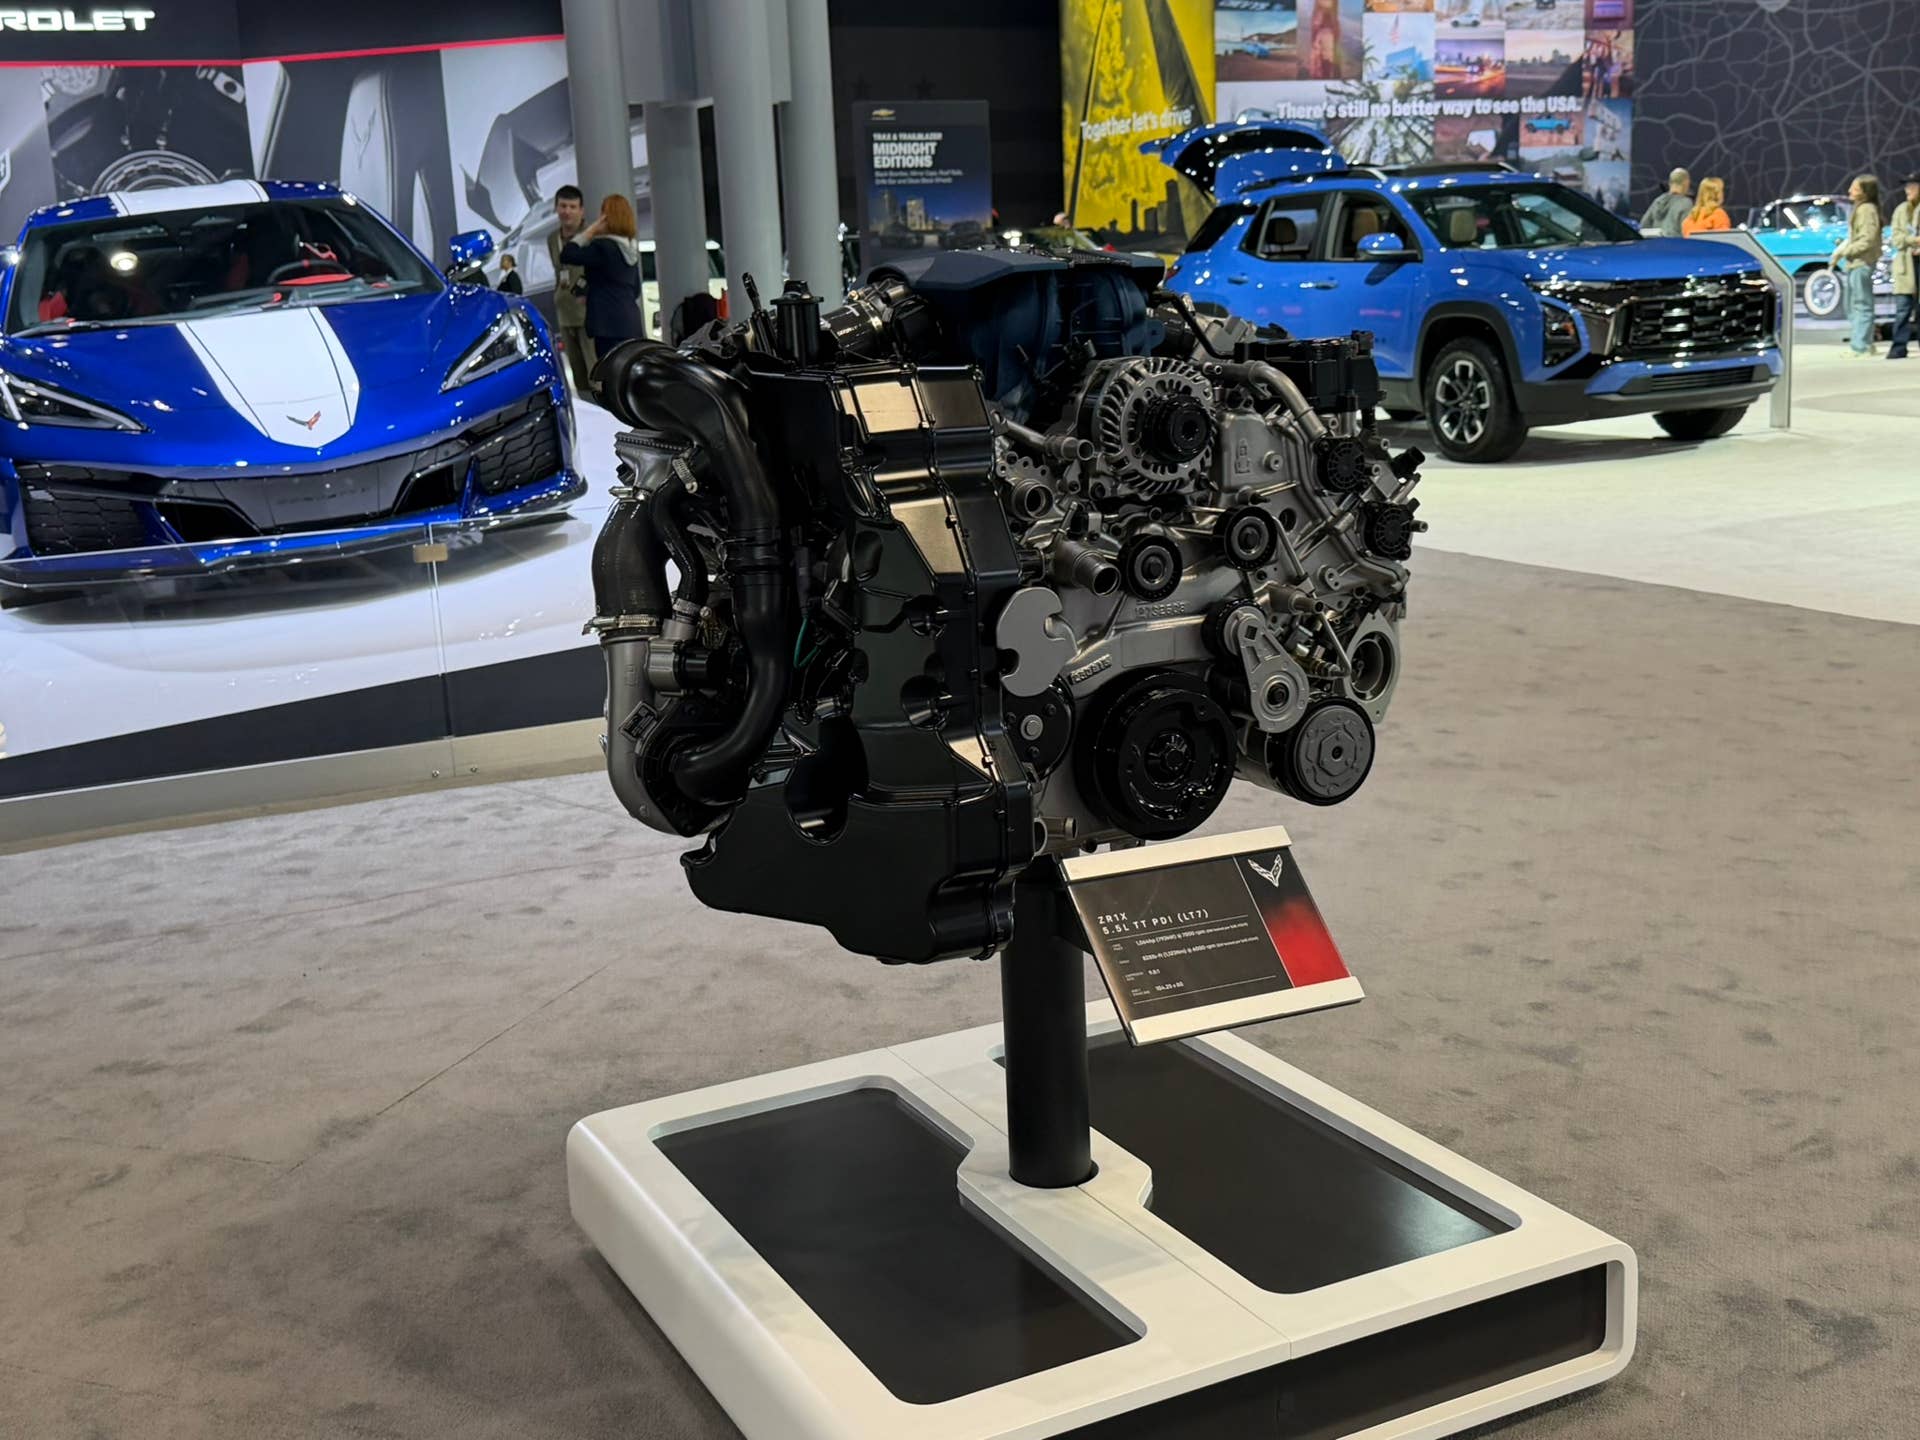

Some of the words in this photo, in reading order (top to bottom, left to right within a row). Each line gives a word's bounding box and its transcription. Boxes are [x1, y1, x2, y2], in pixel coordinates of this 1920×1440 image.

[1278, 100, 1336, 119] There's
[1338, 99, 1369, 118] still
[1370, 101, 1391, 117] no
[1392, 98, 1441, 117] better
[1442, 99, 1473, 118] way
[1474, 98, 1492, 114] to
[1493, 99, 1519, 114] see
[1520, 96, 1545, 113] the
[1546, 95, 1582, 112] USA.
[1080, 116, 1131, 142] Together
[1132, 111, 1158, 132] let's
[873, 142, 938, 155] MIDNIGHT
[873, 155, 933, 168] EDITIONS
[1097, 912, 1128, 925] ZR1X
[1102, 923, 1130, 935] 5.5L
[1132, 919, 1147, 929] TT
[1151, 915, 1173, 926] PDI
[1177, 908, 1209, 923] (LT7)
